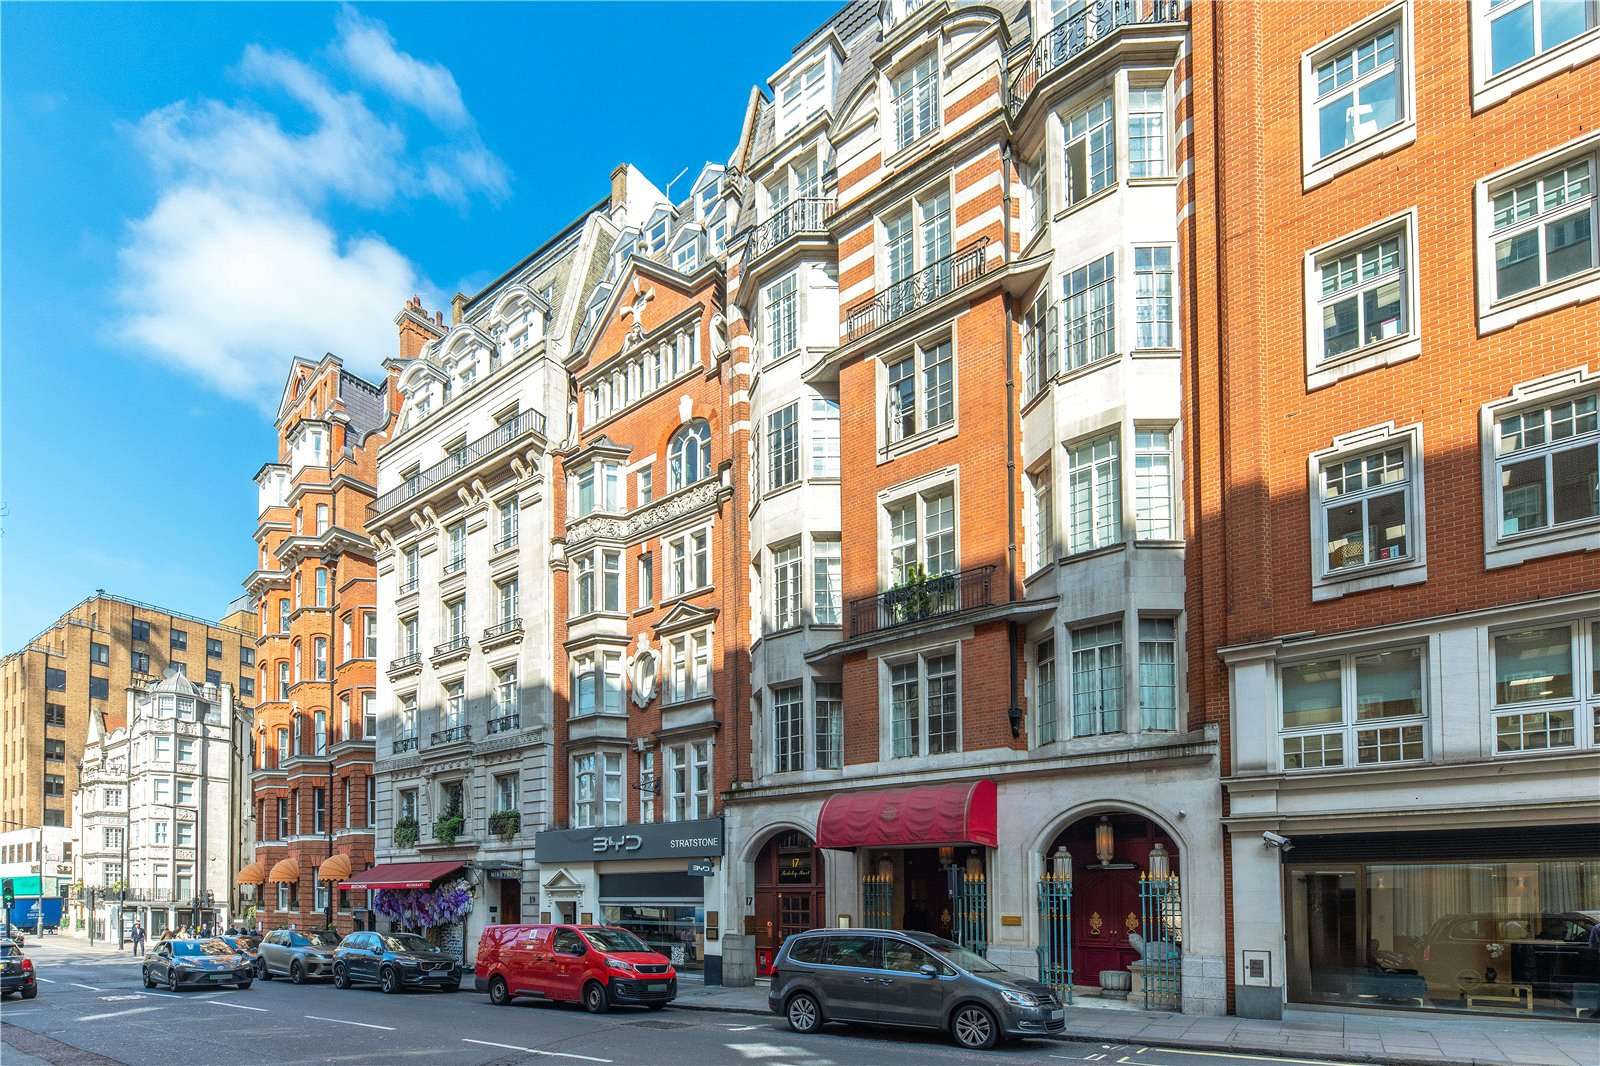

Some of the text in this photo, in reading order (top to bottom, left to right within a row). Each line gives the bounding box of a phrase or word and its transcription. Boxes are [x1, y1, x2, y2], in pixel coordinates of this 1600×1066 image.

[593, 835, 642, 852] BYD
[670, 837, 718, 849] STRATSTONE
[692, 864, 710, 872] BYD
[792, 858, 800, 868] 17
[745, 896, 753, 906] 17
